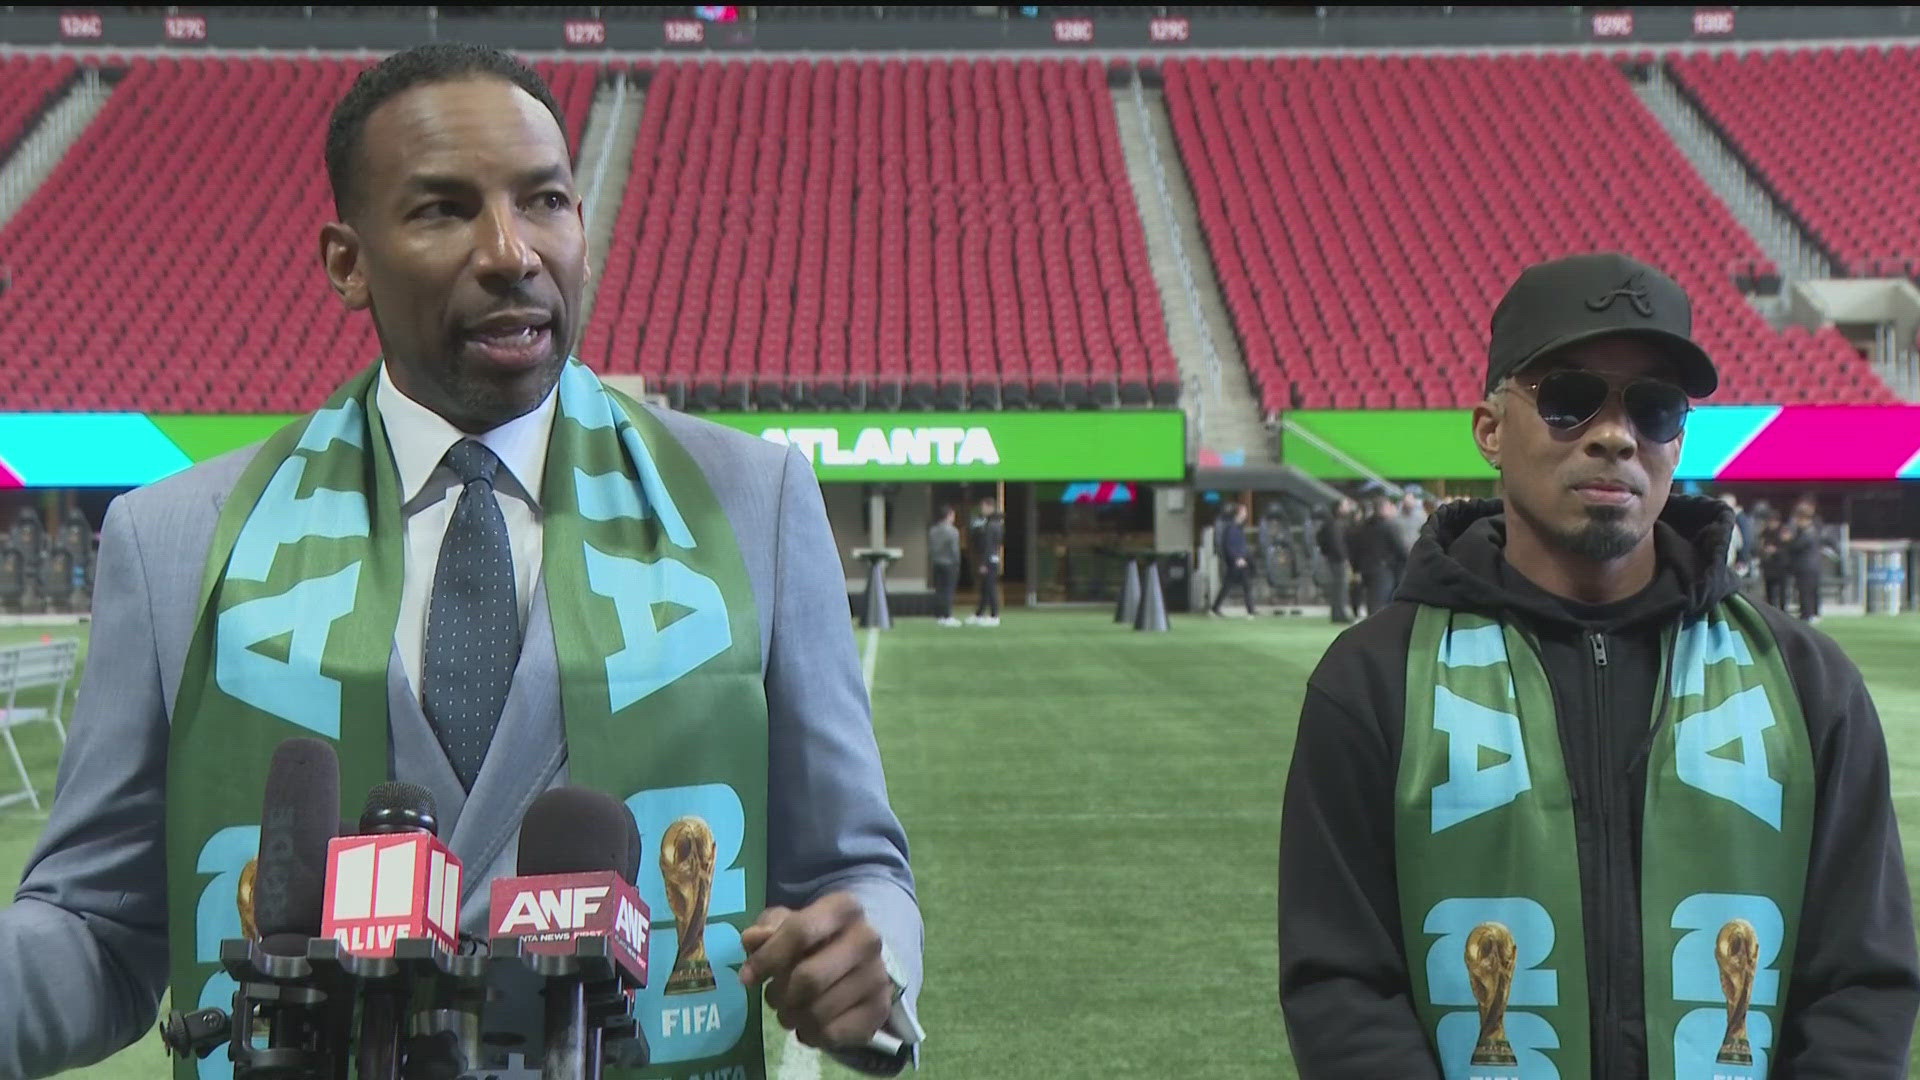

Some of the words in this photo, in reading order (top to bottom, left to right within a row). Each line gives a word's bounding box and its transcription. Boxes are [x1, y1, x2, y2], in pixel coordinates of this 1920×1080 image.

[166, 17, 206, 39] 127C
[566, 22, 604, 43] 127C
[666, 21, 703, 42] 128C
[498, 886, 611, 934] ANF
[615, 894, 650, 954] ANF
[333, 923, 411, 952] ALIVE
[540, 933, 570, 942] NEWS
[661, 1002, 721, 1038] FIFA
